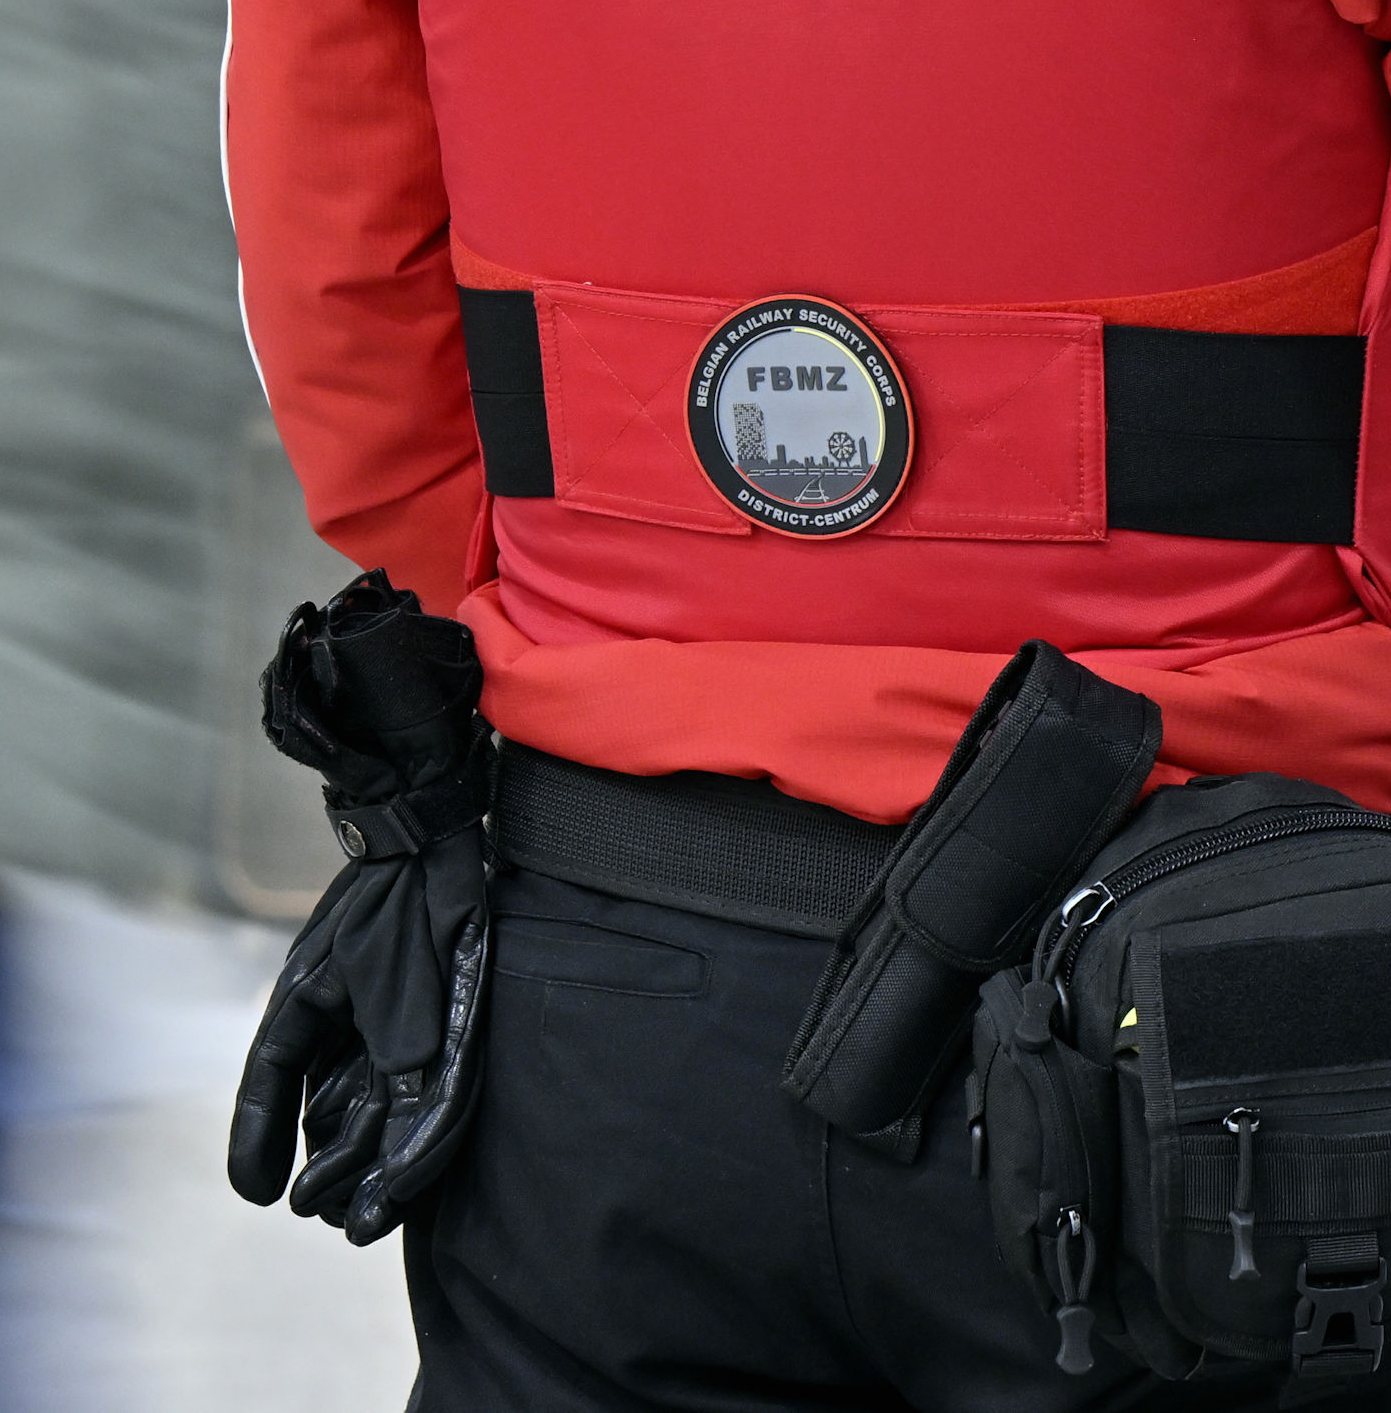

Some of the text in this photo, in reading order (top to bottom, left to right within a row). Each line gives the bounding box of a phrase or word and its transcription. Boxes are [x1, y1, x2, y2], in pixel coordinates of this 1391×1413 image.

[696, 307, 897, 408] BELGIAN RAILWAY SECURITY CORPS
[746, 365, 849, 392] FBMZ
[737, 488, 880, 527] DISTRICT-CENTRUM
